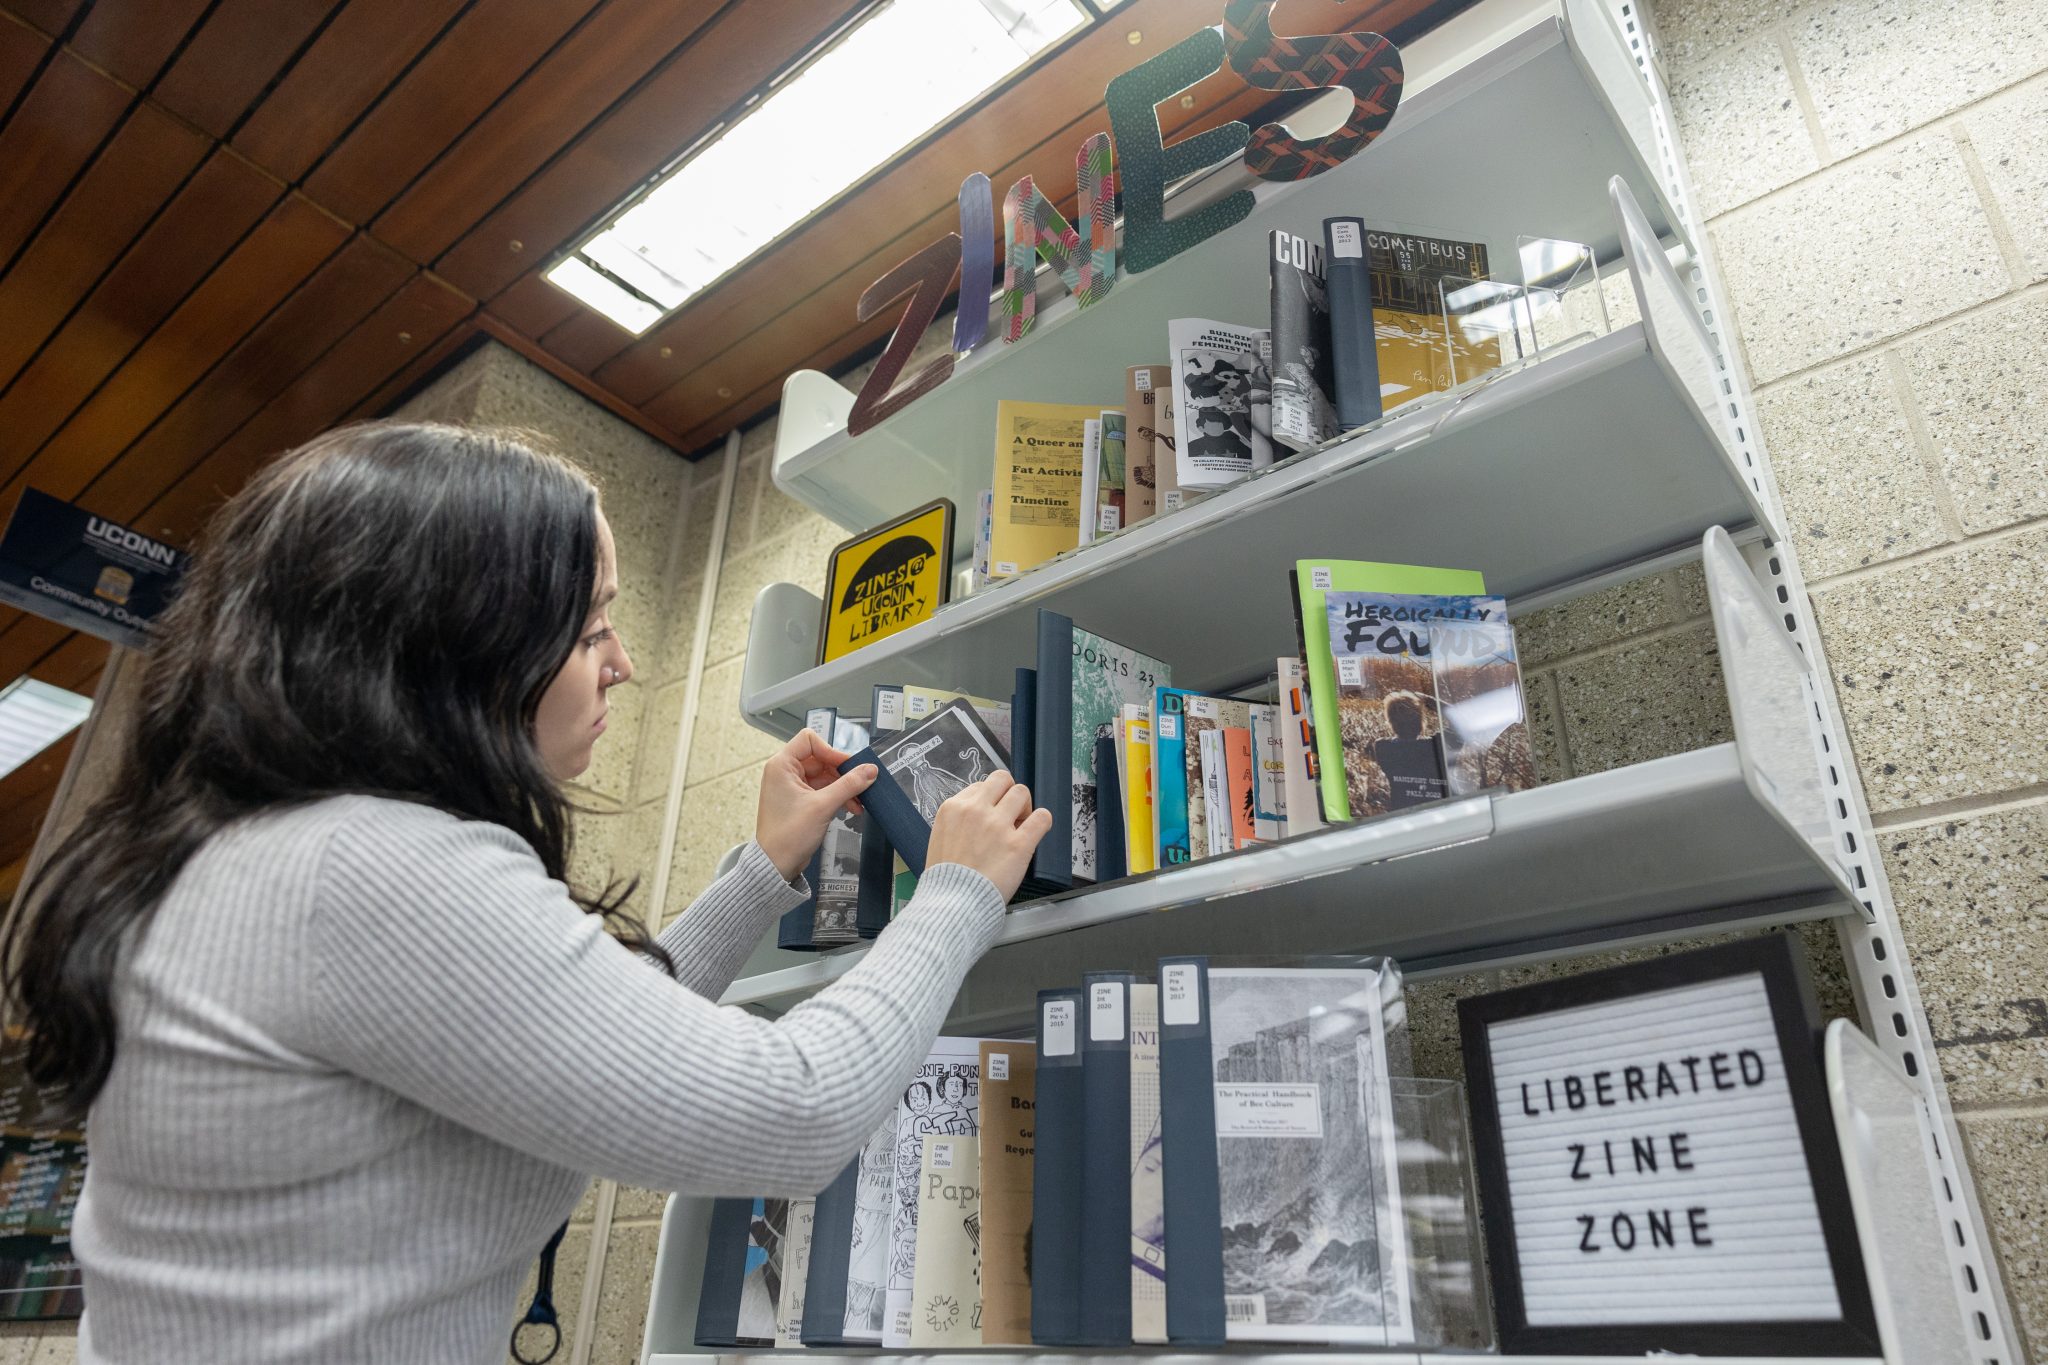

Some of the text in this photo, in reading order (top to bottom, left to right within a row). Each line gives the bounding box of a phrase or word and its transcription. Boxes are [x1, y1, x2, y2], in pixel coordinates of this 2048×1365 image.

[1367, 233, 1466, 261] COMETBUS
[1275, 230, 1327, 281] COM
[1400, 251, 1411, 259] 55
[1200, 334, 1232, 344] ASIAN
[1192, 341, 1242, 353] FEMINIST
[1413, 369, 1432, 385] Pen
[1013, 436, 1023, 444] A
[1026, 437, 1066, 447] Queer
[1011, 465, 1083, 477] Fat Activis
[1011, 495, 1069, 506] Timeline
[86, 516, 176, 566] UCONN
[855, 564, 908, 602] ZINES
[30, 576, 111, 617] Community
[861, 580, 915, 617] UCONN
[849, 595, 927, 643] LIBRARY
[1344, 618, 1497, 659] FOUND
[1139, 670, 1155, 688] 23
[931, 737, 941, 746] #2
[1267, 737, 1284, 749] Exp
[827, 883, 857, 892] HIGHEST
[1132, 1031, 1159, 1045] INT
[949, 1063, 980, 1078] PUN
[1520, 1048, 1767, 1117] LIBERATED
[1272, 1090, 1312, 1098] Handbook
[1011, 1096, 1036, 1110] Bac
[1020, 1129, 1034, 1138] Gu
[1005, 1144, 1035, 1155] Regre
[1567, 1131, 1695, 1180] ZINE
[869, 1174, 892, 1189] PARA
[881, 1193, 893, 1204] #3
[927, 1173, 981, 1209] Pap
[1576, 1206, 1715, 1253] ZONE
